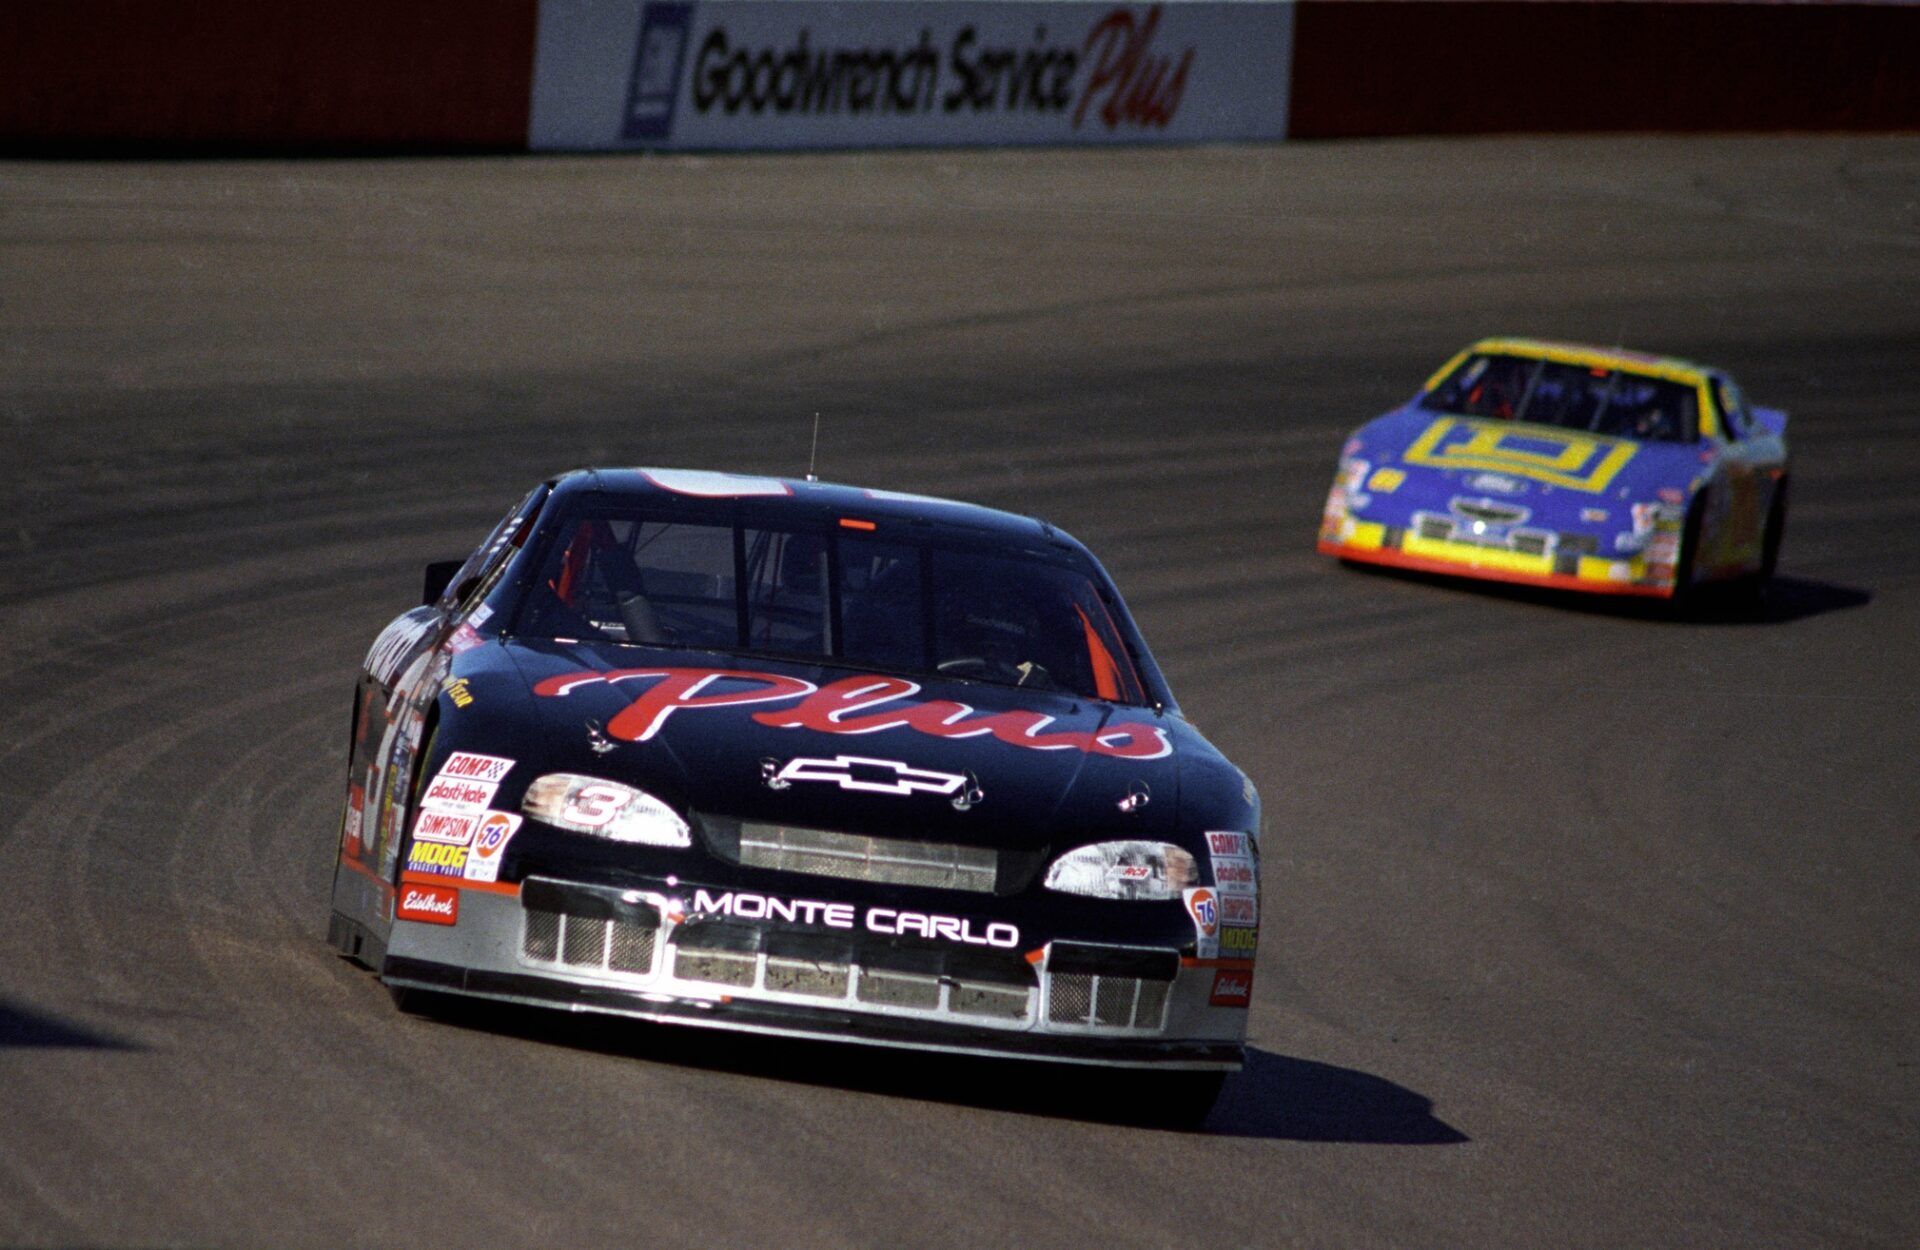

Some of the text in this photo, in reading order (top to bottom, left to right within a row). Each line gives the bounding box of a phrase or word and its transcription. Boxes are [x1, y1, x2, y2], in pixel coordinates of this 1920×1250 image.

[694, 3, 1196, 129] Goodwrench Service Plus
[534, 667, 1172, 759] Plus
[446, 755, 493, 776] COMP
[563, 785, 634, 826] 3
[420, 814, 473, 838] SIMPSON
[481, 825, 503, 846] 76
[408, 842, 469, 868] MOOG
[402, 890, 453, 915] Edelbrock
[1197, 898, 1215, 925] 76
[693, 889, 1019, 948] MONTE CARLO
[1222, 927, 1257, 949] MOOG
